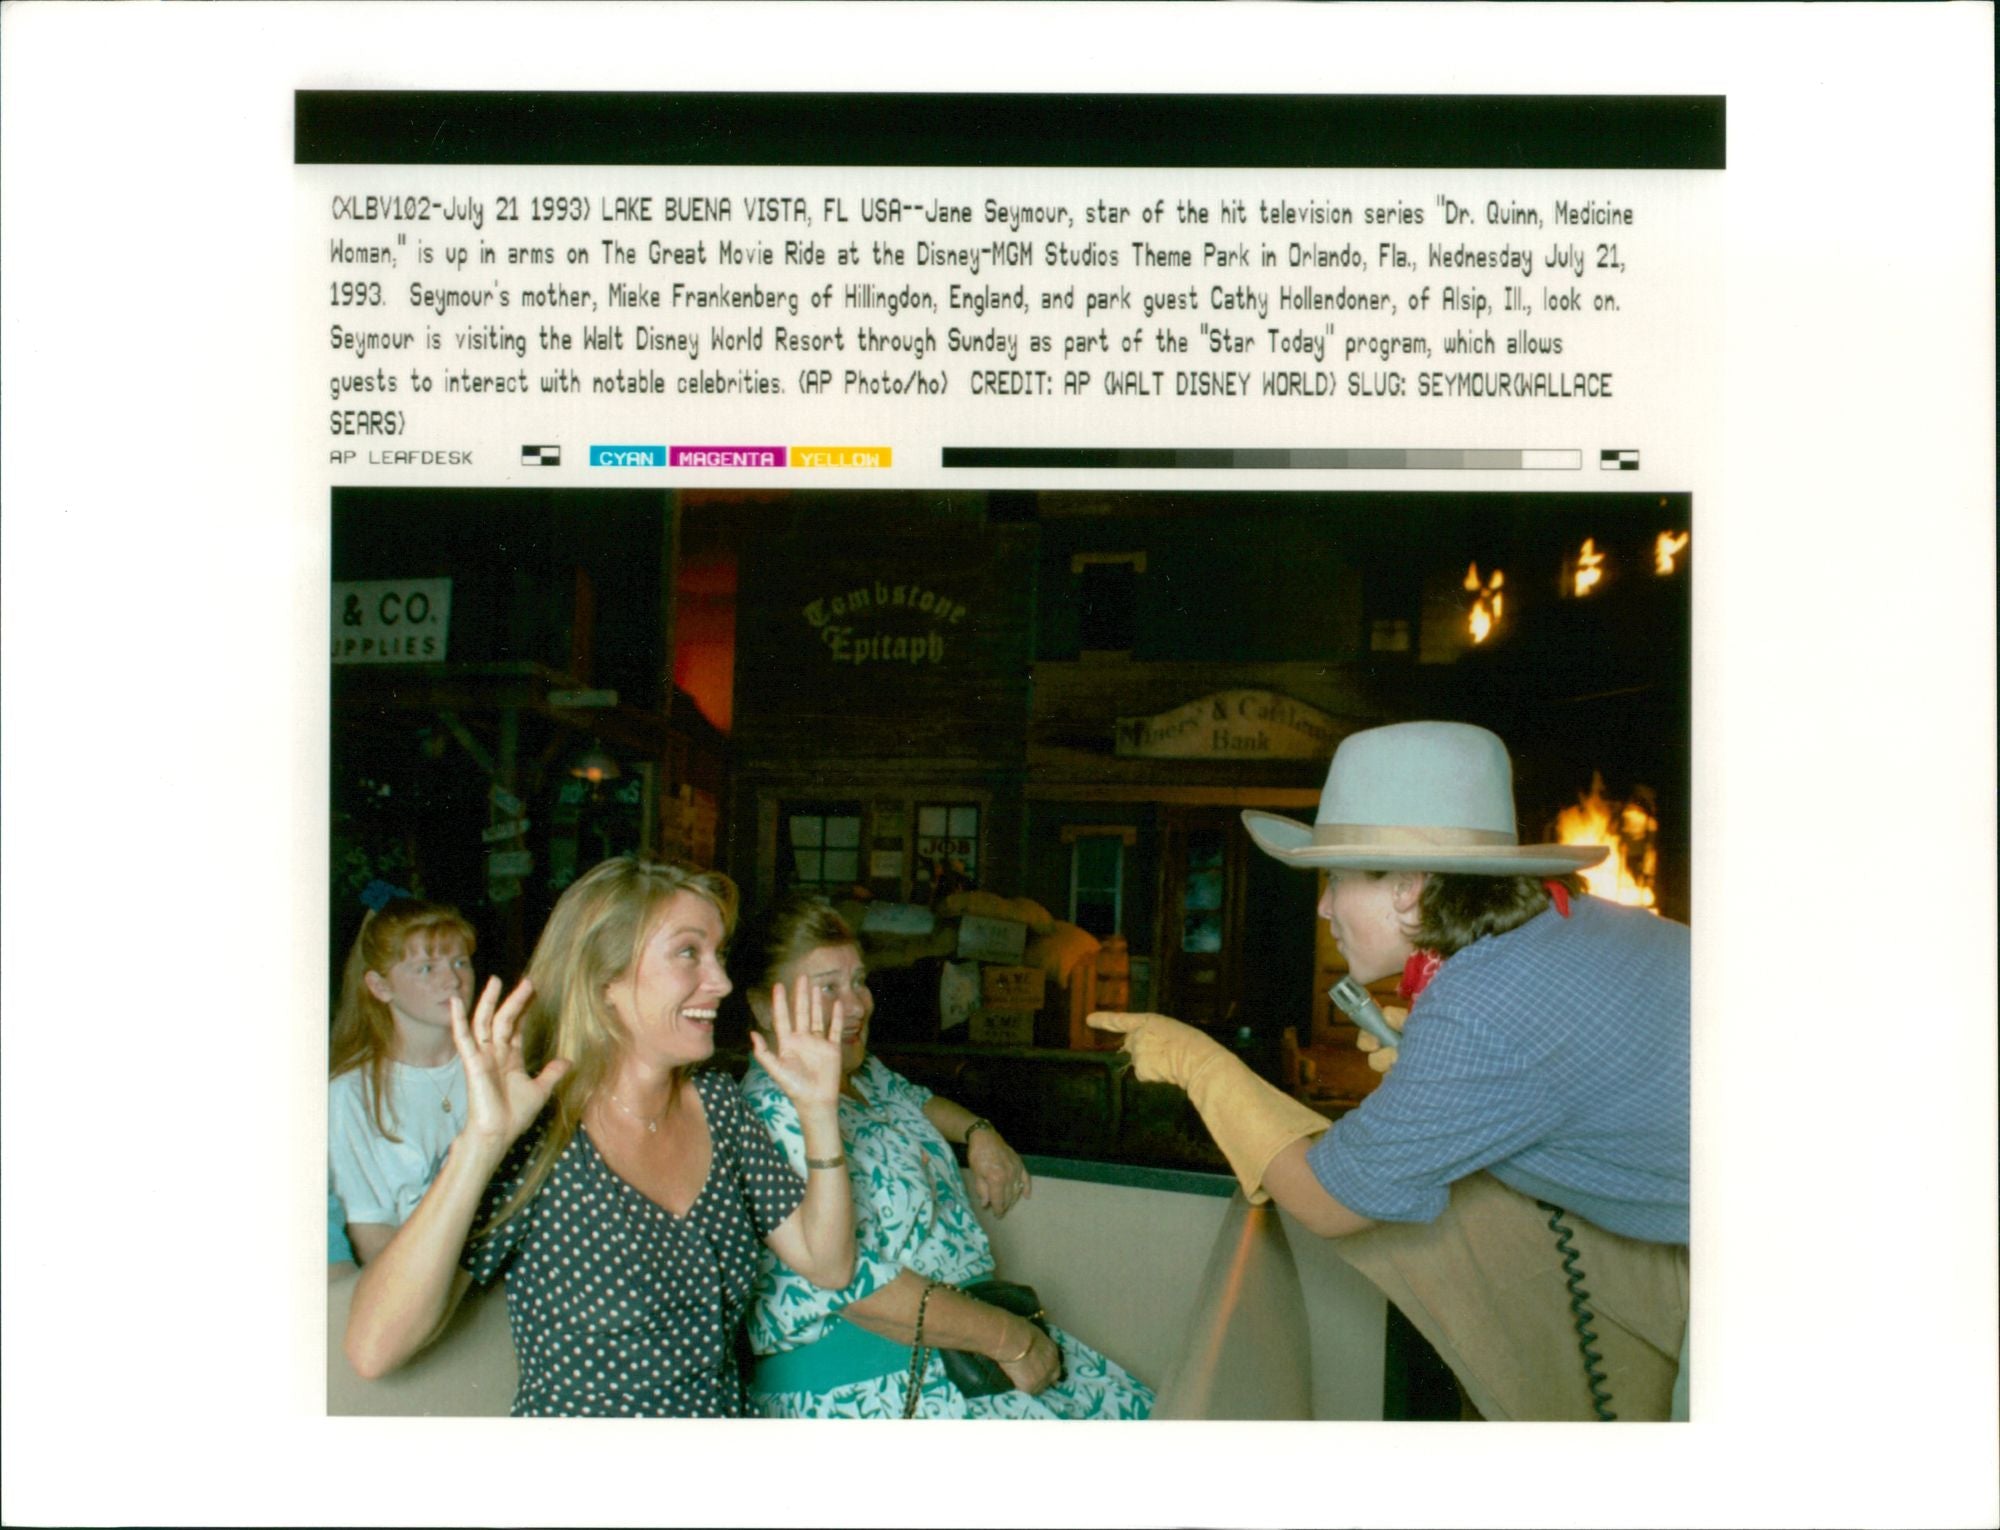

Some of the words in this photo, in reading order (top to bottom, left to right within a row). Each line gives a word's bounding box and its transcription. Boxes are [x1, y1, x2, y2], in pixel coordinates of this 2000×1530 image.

[343, 594, 363, 626] &
[379, 591, 437, 625] CO.
[802, 579, 968, 628] Tombstone
[820, 625, 945, 667] Epitaph
[1212, 697, 1228, 721] &
[1212, 730, 1271, 752] Bank
[922, 839, 971, 855] JOB
